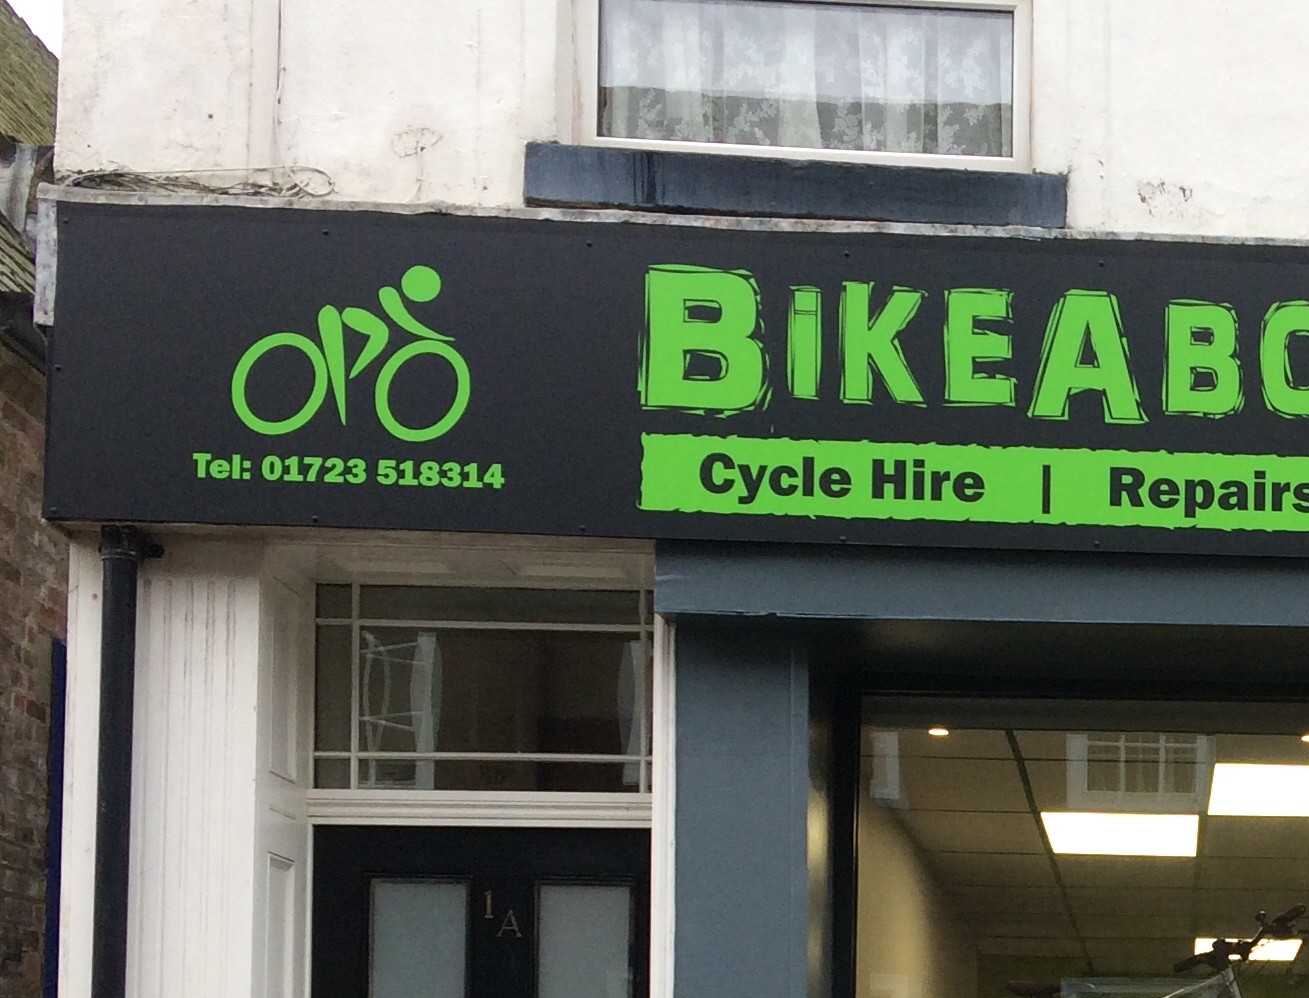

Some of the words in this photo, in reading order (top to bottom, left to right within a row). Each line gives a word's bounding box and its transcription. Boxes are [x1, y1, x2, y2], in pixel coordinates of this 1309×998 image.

[192, 452, 251, 480] Tel:
[261, 455, 367, 484] 01723
[377, 459, 505, 489] 518314
[699, 453, 852, 505] Cycle
[871, 459, 985, 502] Hire
